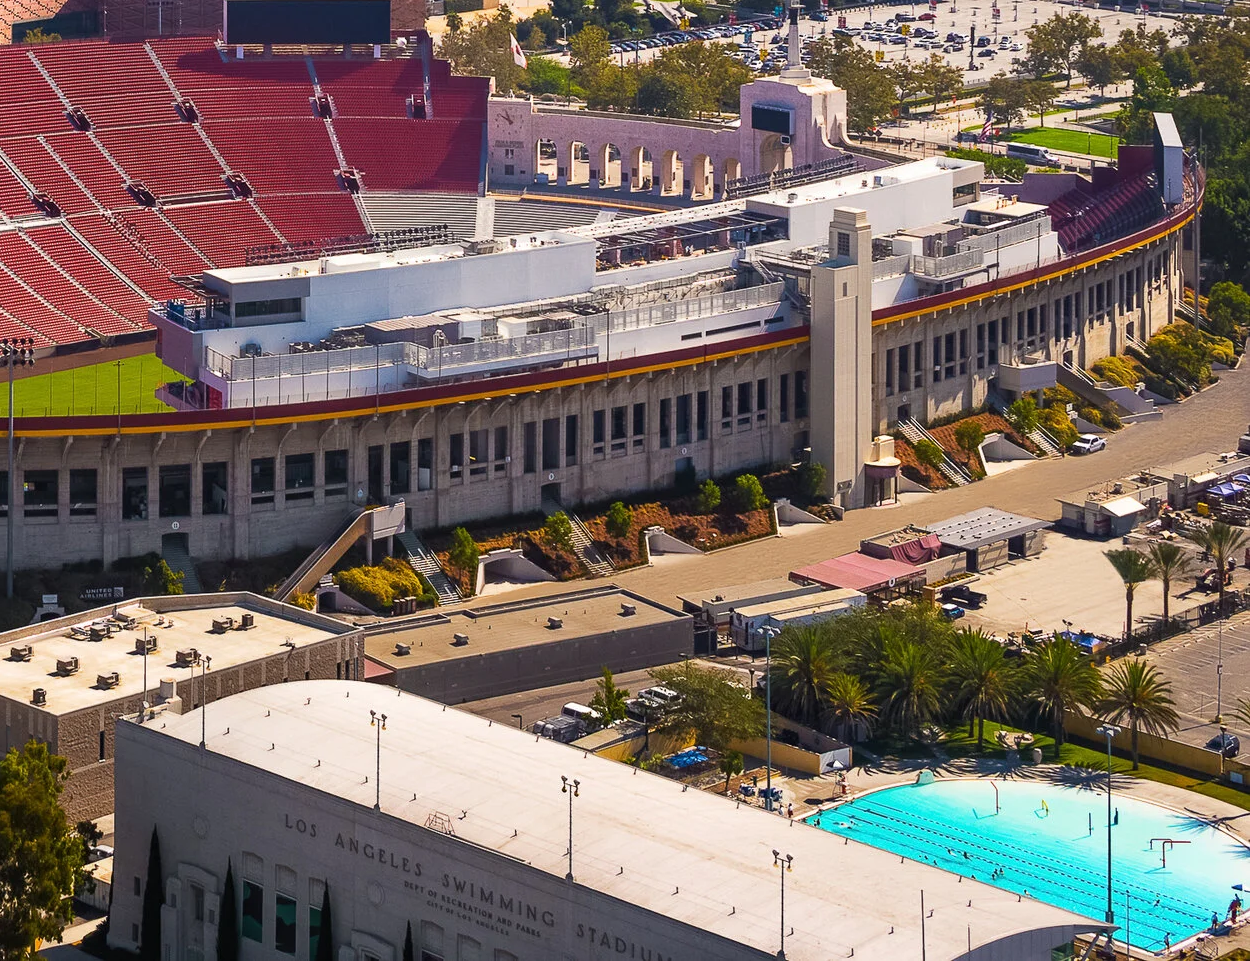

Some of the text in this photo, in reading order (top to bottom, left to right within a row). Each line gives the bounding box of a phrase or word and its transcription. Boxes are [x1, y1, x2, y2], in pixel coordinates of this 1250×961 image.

[284, 813, 317, 838] LOS
[334, 832, 422, 877] ANGELES
[442, 873, 555, 928] SWIMMING
[404, 880, 541, 937] DEPT OF RECREATION AND PARKS
[426, 900, 444, 911] CITY
[457, 912, 472, 922] LOS
[476, 919, 509, 936] ANGELES
